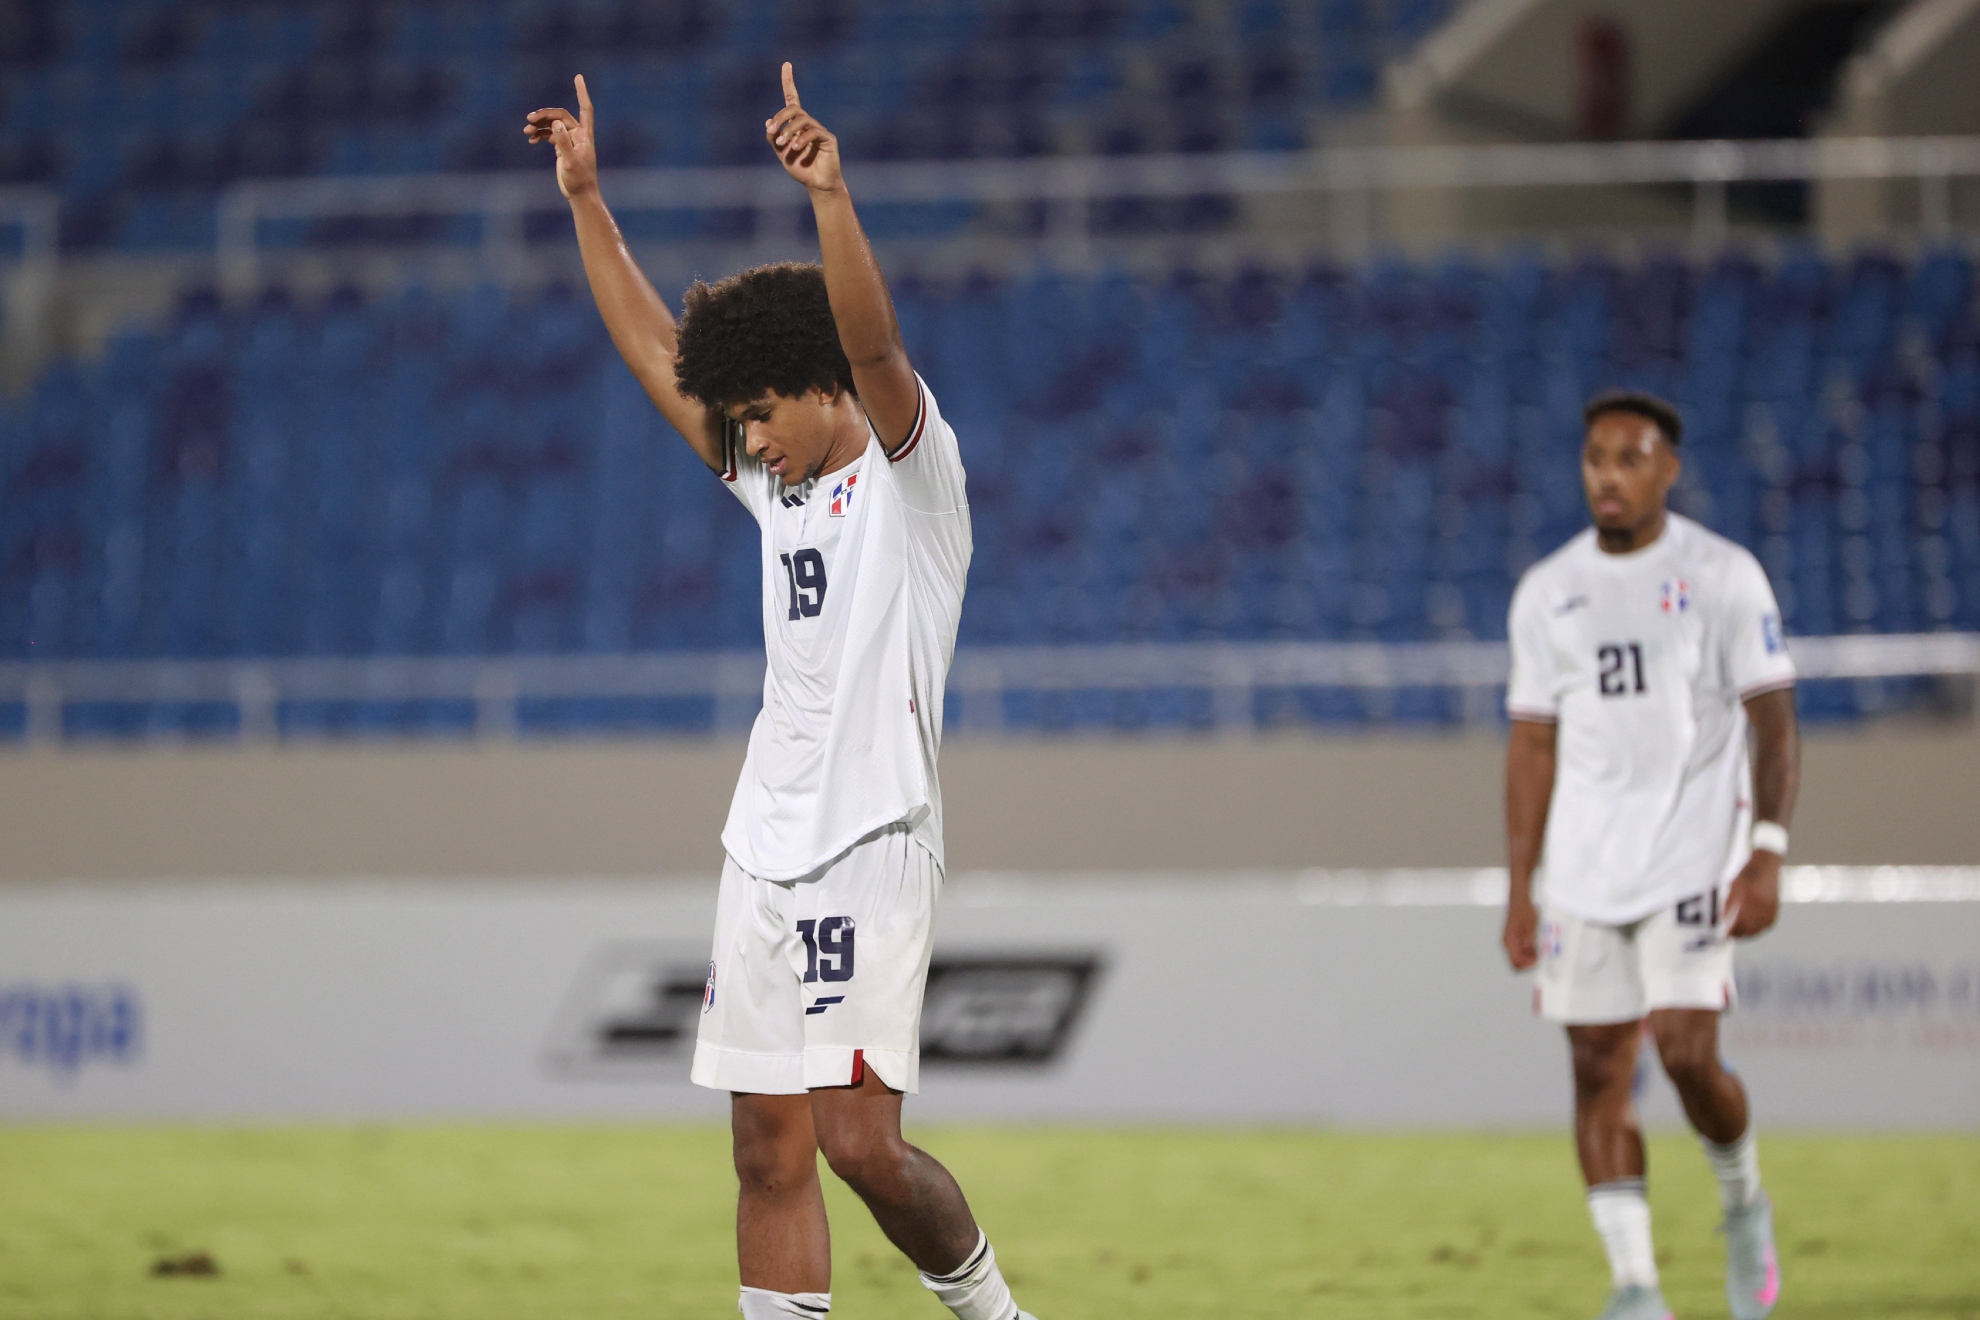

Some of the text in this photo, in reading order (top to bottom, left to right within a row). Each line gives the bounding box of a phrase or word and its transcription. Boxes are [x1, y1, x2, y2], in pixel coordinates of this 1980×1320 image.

[779, 548, 828, 621] 19
[1597, 642, 1647, 696] 21
[796, 916, 855, 983] 19
